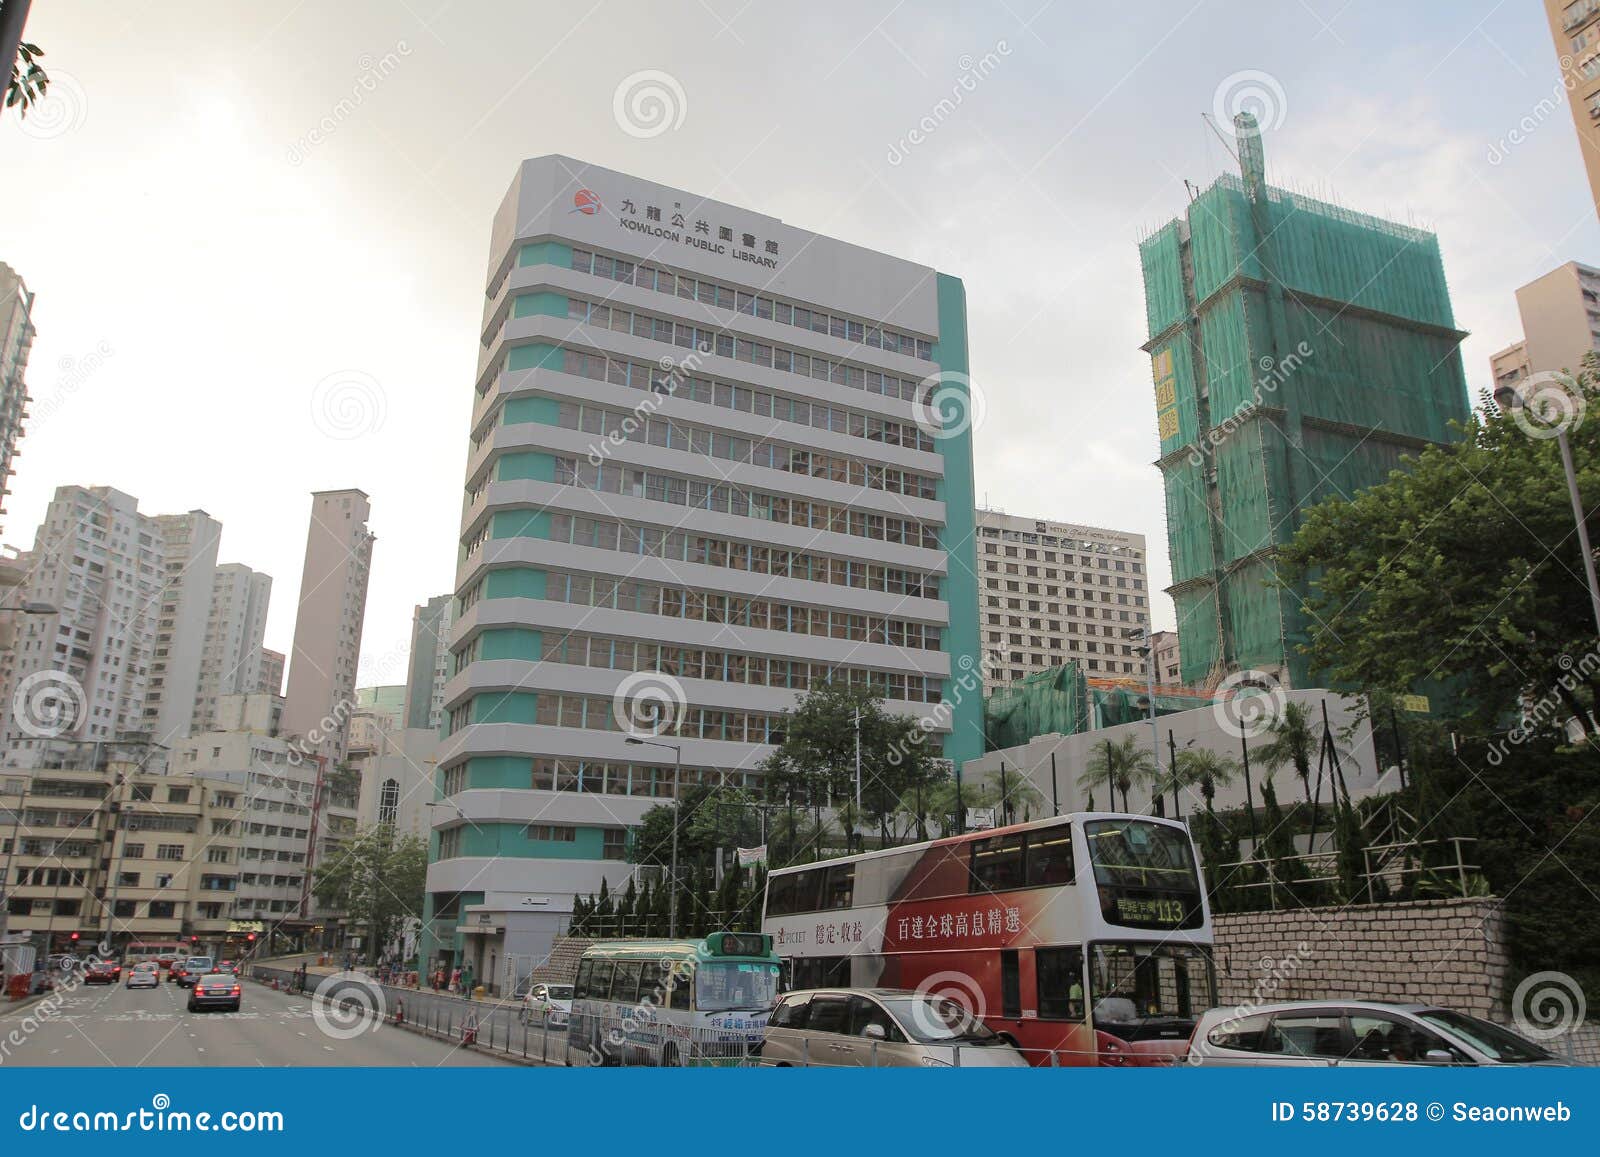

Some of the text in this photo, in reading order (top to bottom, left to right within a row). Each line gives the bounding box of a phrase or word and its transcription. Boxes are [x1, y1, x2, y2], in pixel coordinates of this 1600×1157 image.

[619, 217, 779, 269] KOWLOON PUBLIC LIBRARY
[621, 199, 779, 255] 九龍公共圖書館
[898, 906, 1020, 941] 百達全球高息精選
[1157, 901, 1183, 921] 113
